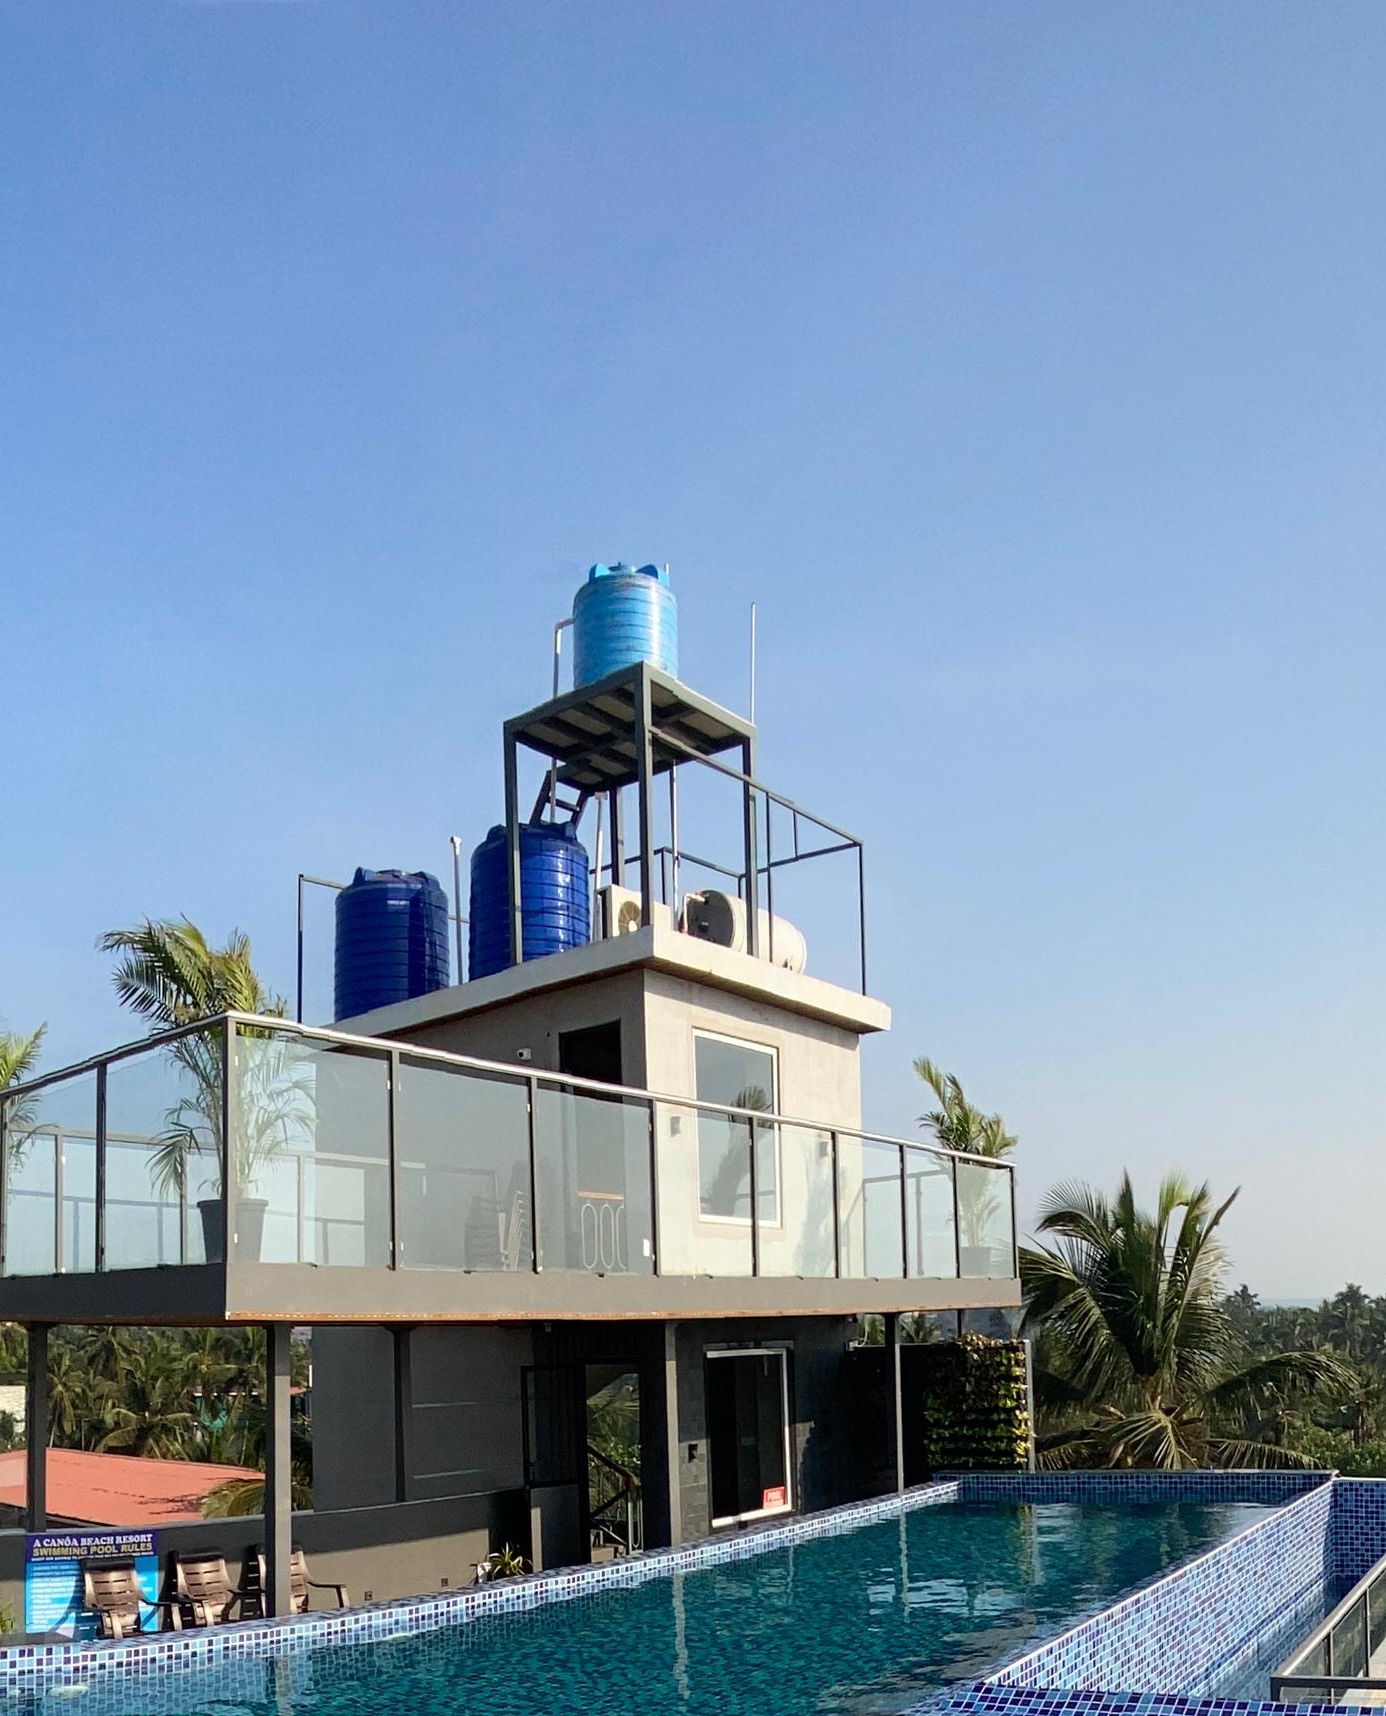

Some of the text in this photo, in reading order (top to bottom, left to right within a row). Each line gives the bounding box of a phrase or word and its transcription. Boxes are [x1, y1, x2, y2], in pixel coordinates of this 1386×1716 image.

[33, 1539, 44, 1548] A
[80, 1536, 114, 1546] BEACH
[115, 1534, 153, 1545] RESORT
[33, 1546, 88, 1557] SWIMMING
[90, 1545, 118, 1555] POOL
[120, 1542, 153, 1553] RULES
